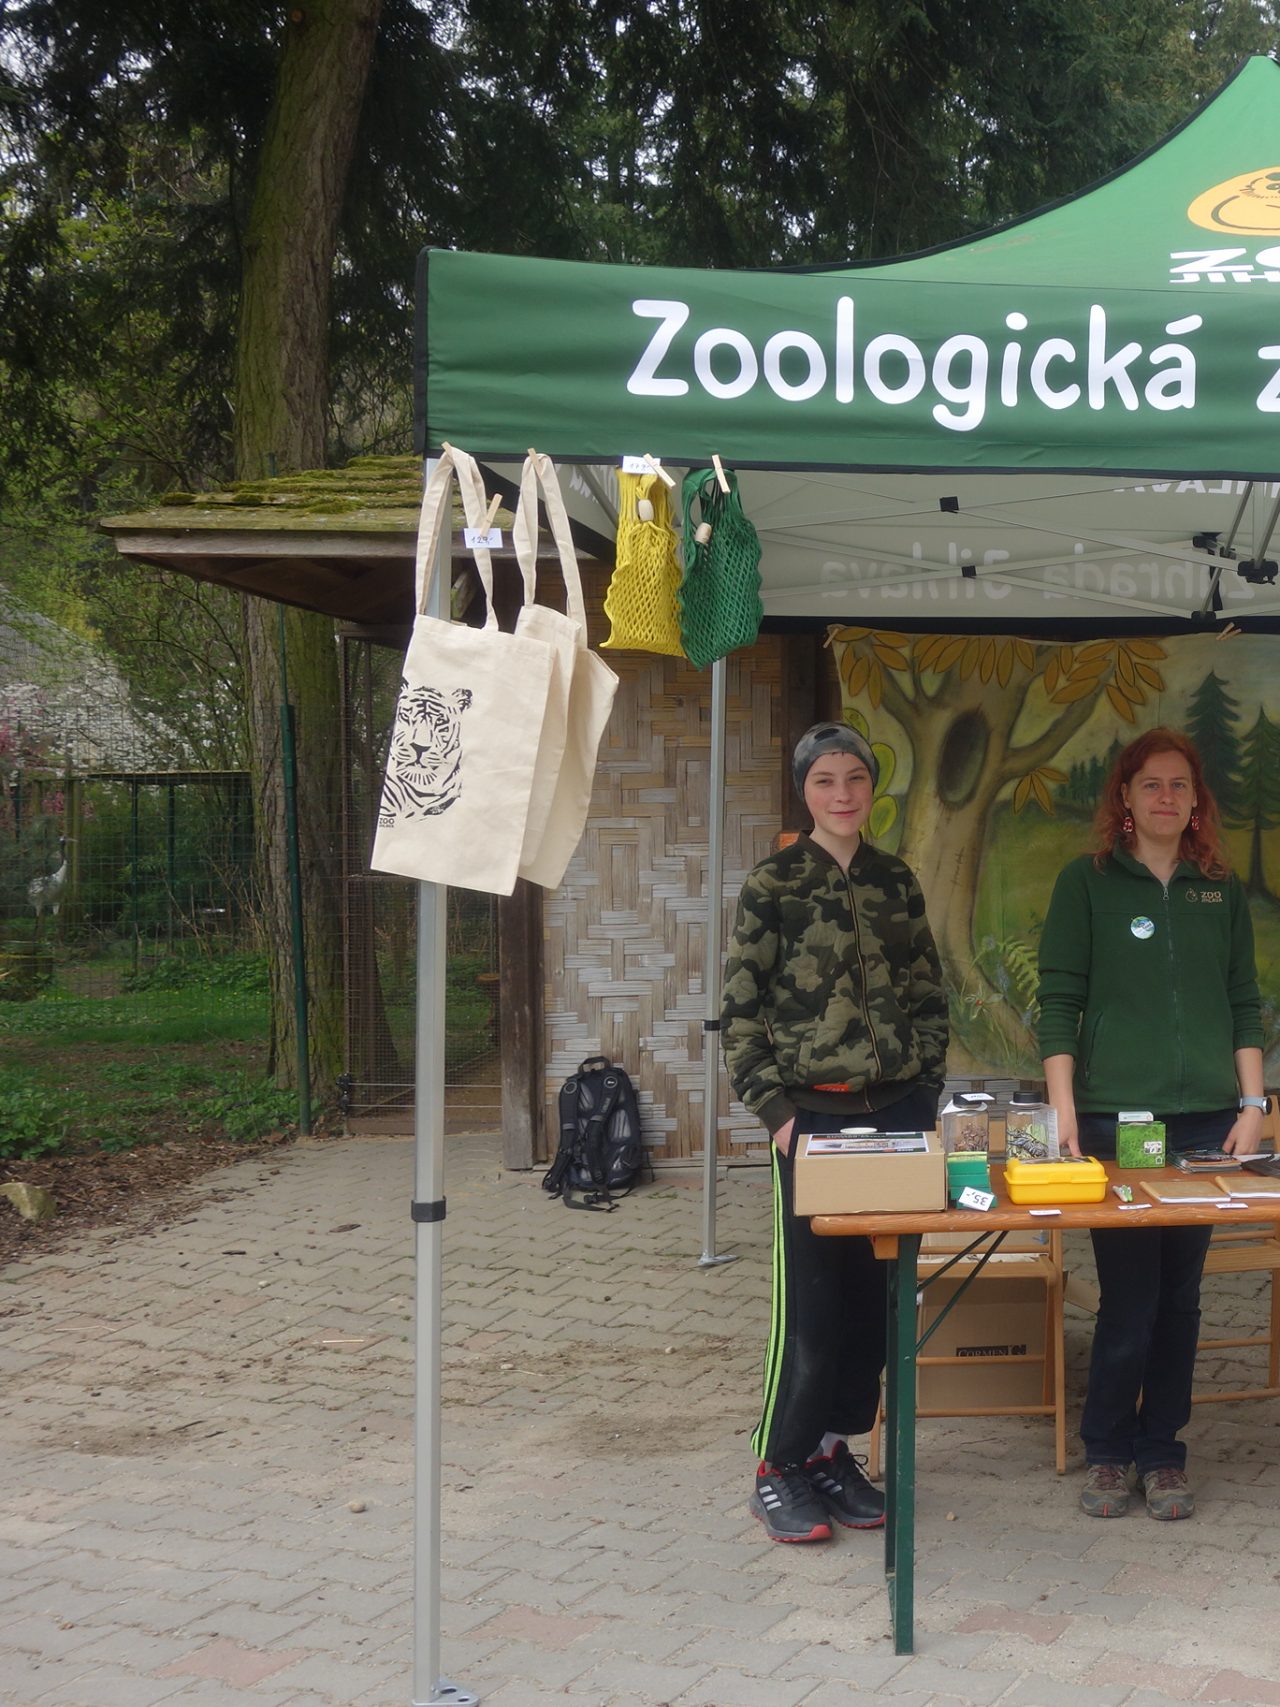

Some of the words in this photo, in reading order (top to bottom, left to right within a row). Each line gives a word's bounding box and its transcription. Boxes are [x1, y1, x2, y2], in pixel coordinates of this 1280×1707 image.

[626, 296, 1203, 432] Zoologická
[379, 817, 395, 825] ZOO
[1200, 890, 1222, 899] ZOO
